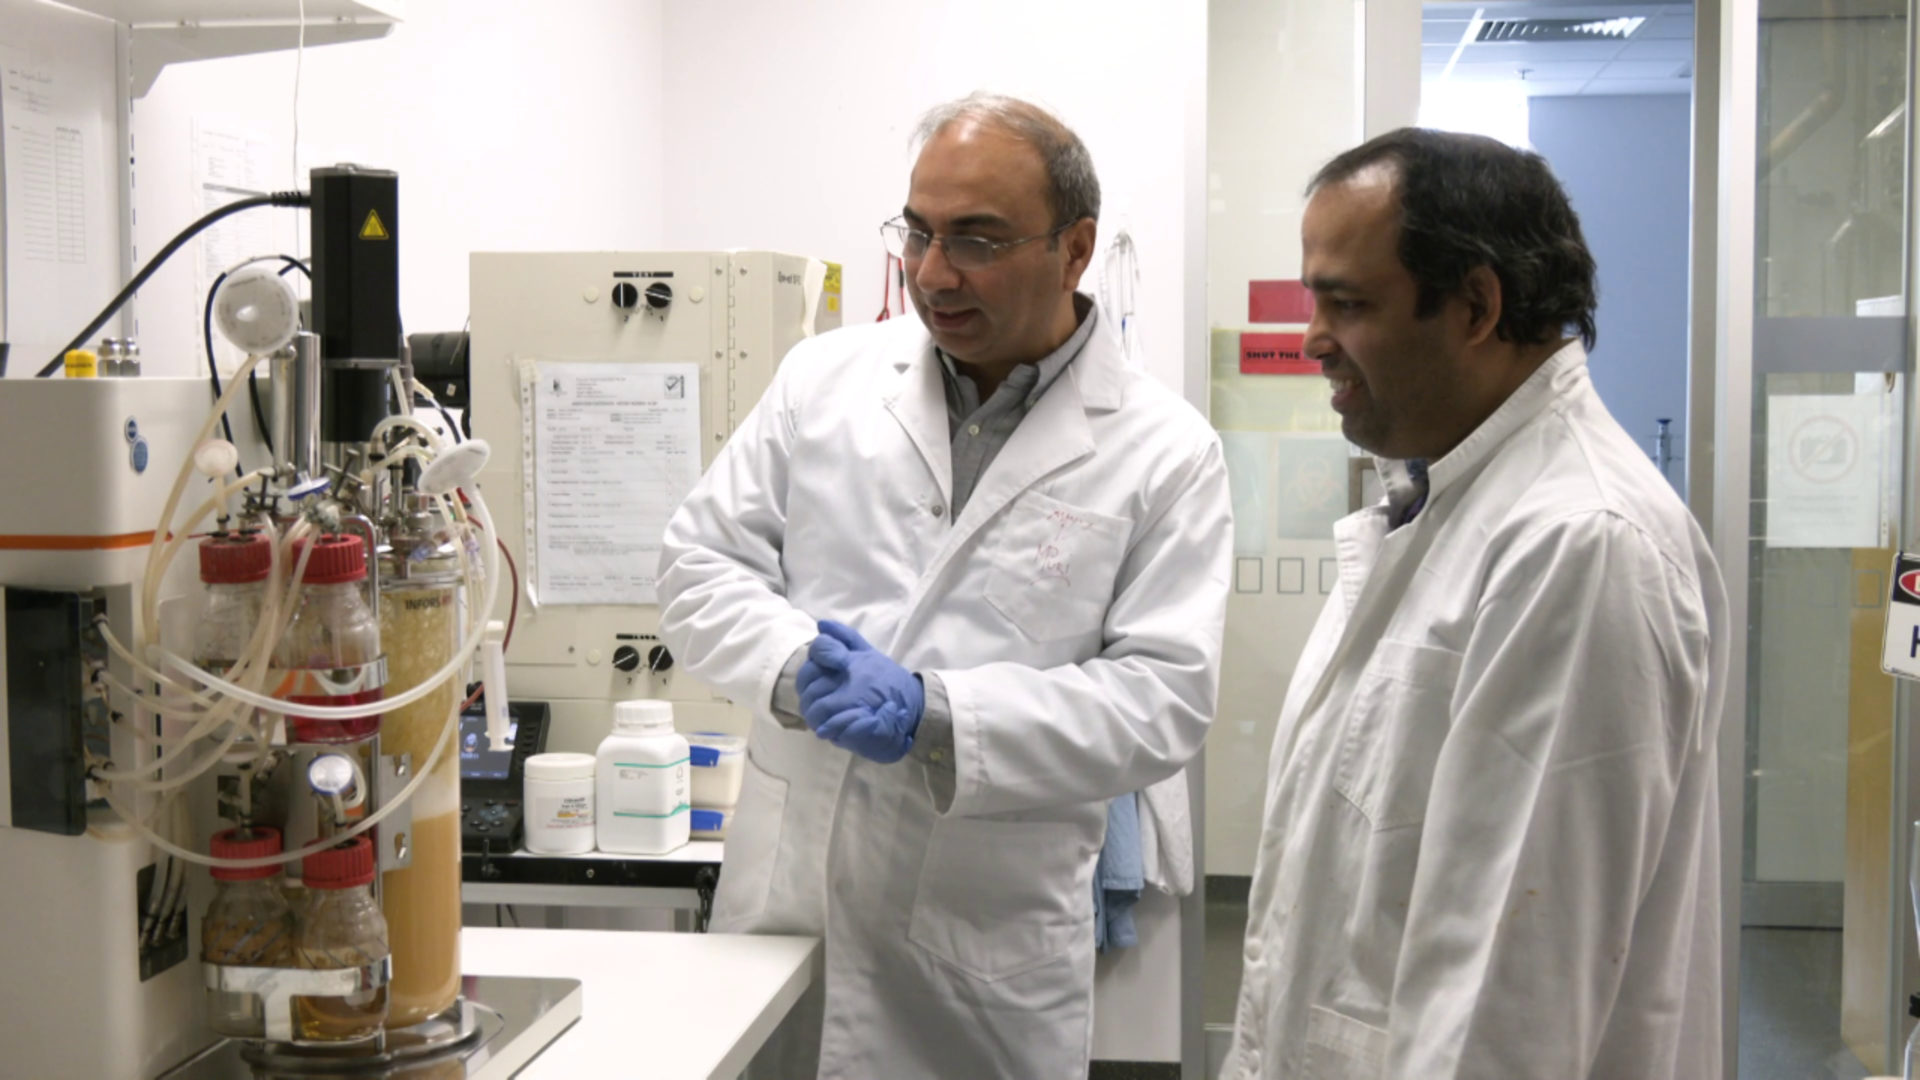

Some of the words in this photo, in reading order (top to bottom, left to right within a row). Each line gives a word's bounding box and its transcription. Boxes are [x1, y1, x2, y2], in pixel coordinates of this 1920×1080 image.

[1245, 351, 1275, 360] SHUT
[1279, 351, 1301, 360] THE
[405, 597, 438, 610] INFORS
